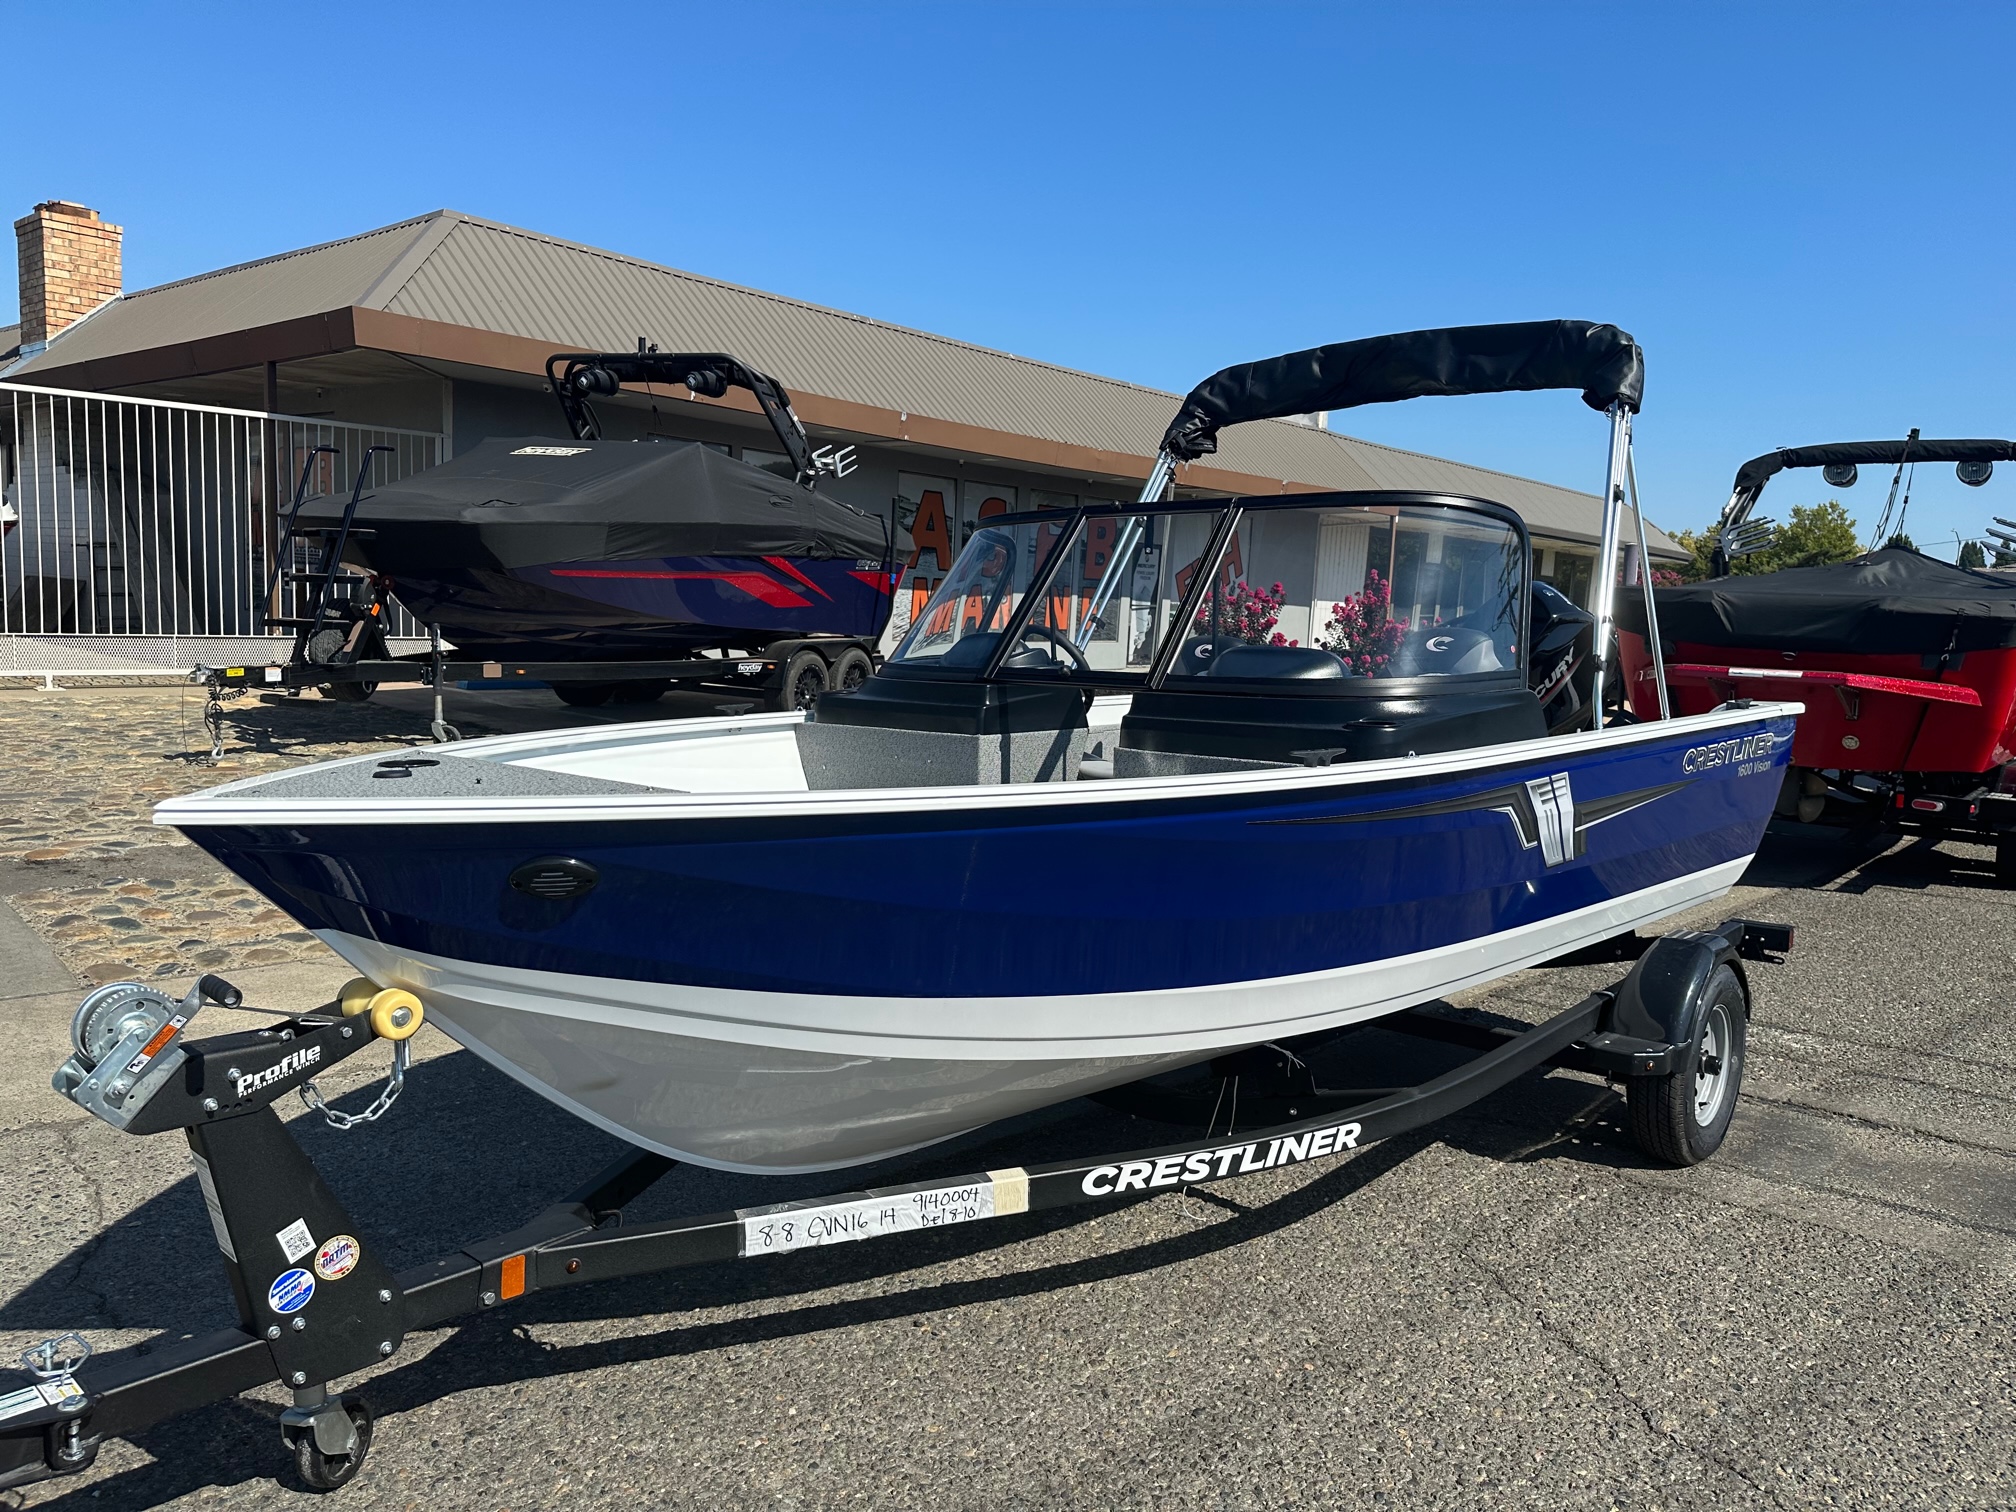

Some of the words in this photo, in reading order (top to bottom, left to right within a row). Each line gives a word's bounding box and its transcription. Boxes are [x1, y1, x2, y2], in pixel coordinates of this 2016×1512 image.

[1683, 733, 1775, 774] CRESTLINER
[1738, 763, 1753, 777] 1600
[1754, 761, 1771, 774] Vision
[237, 1045, 320, 1094] Profile
[239, 1069, 294, 1098] PERFORMANCE
[296, 1056, 320, 1072] WINCH
[1081, 1122, 1362, 1196] CRESTLINER
[759, 1222, 795, 1247] 8-8
